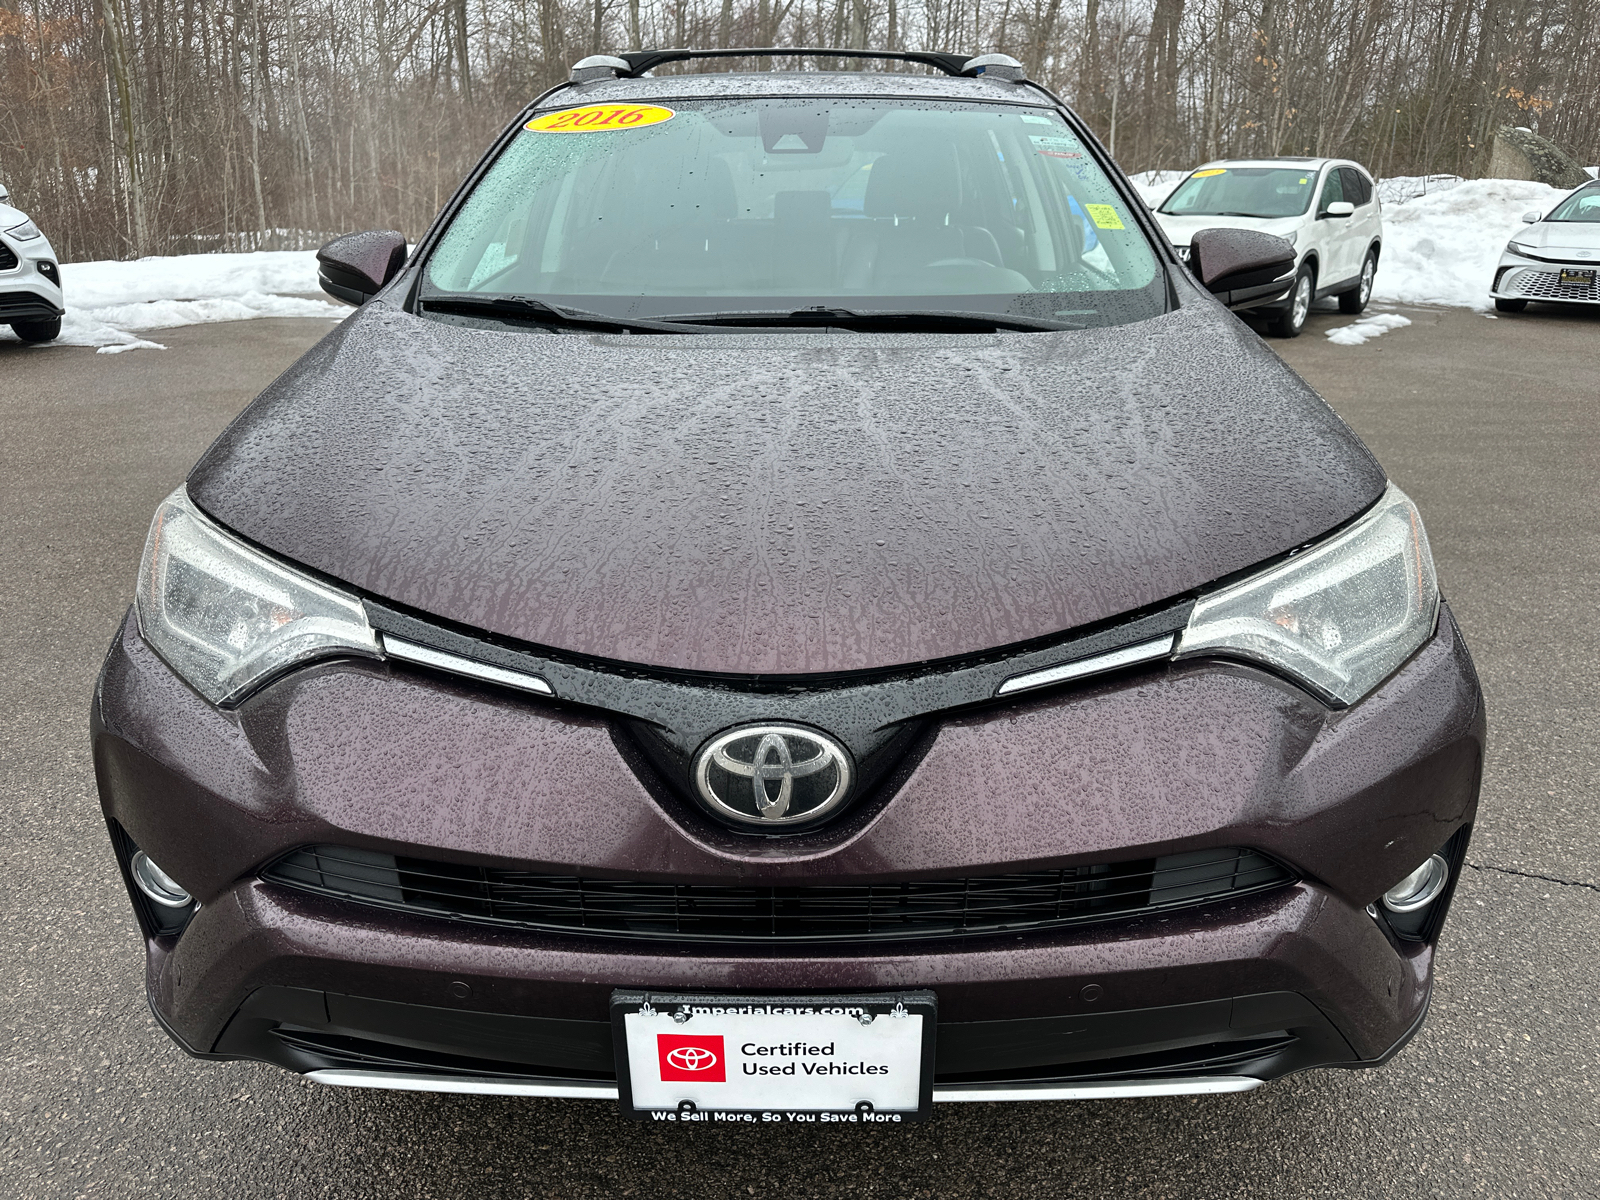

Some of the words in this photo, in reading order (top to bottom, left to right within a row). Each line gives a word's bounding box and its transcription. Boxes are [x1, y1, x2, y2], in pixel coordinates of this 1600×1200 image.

[546, 108, 653, 129] 2016
[683, 1004, 864, 1017] Imperialcars.com
[741, 1042, 835, 1056] Certified
[742, 1062, 795, 1076] Used
[801, 1061, 889, 1076] Vehicles
[652, 1111, 676, 1122] We
[681, 1111, 709, 1122] Sell
[714, 1112, 757, 1123] More,
[762, 1112, 782, 1123] So
[786, 1112, 816, 1123] You
[820, 1112, 858, 1123] Save
[862, 1112, 902, 1123] More
